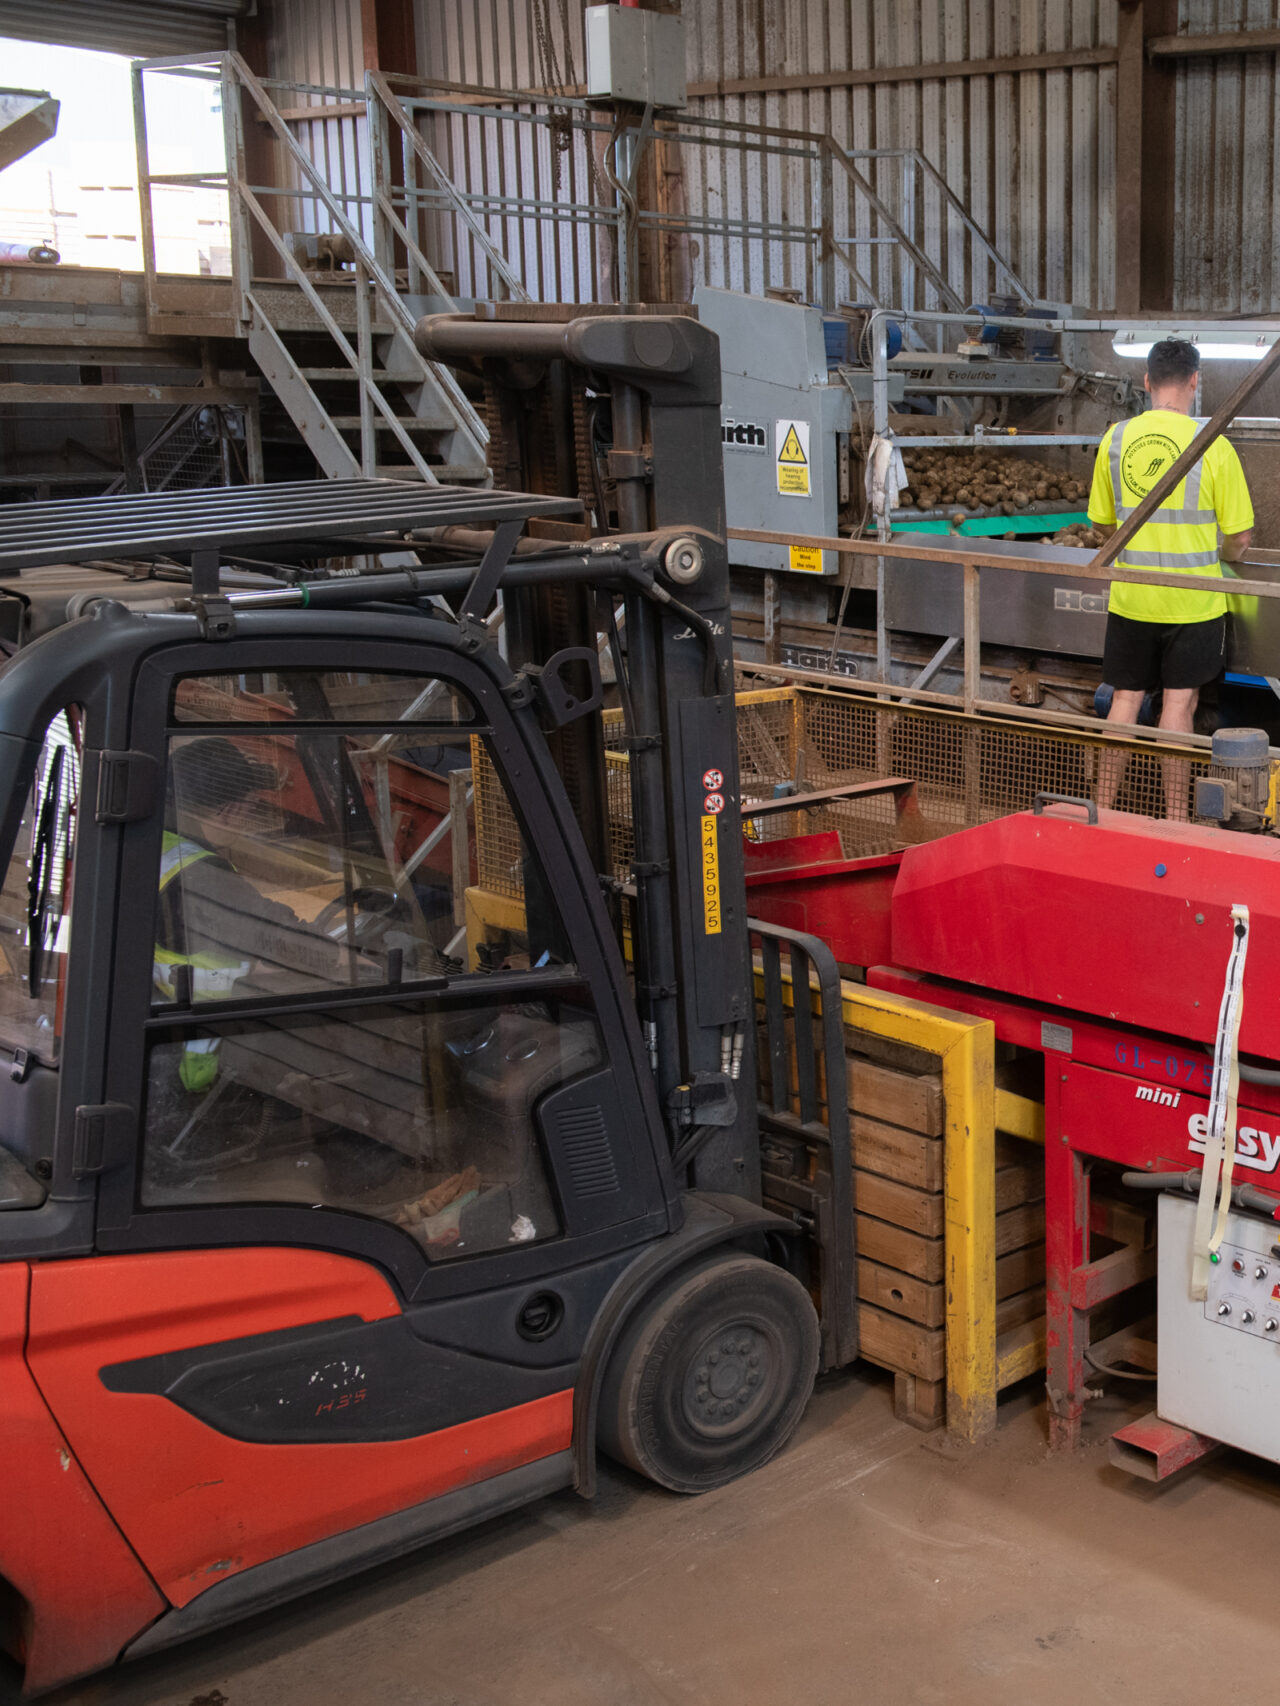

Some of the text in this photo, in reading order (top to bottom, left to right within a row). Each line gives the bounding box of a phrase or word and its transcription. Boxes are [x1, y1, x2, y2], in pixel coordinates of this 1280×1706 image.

[947, 369, 997, 381] Evolution
[721, 418, 767, 448] ith
[703, 820, 719, 928] 5435925
[1135, 1085, 1181, 1109] mini
